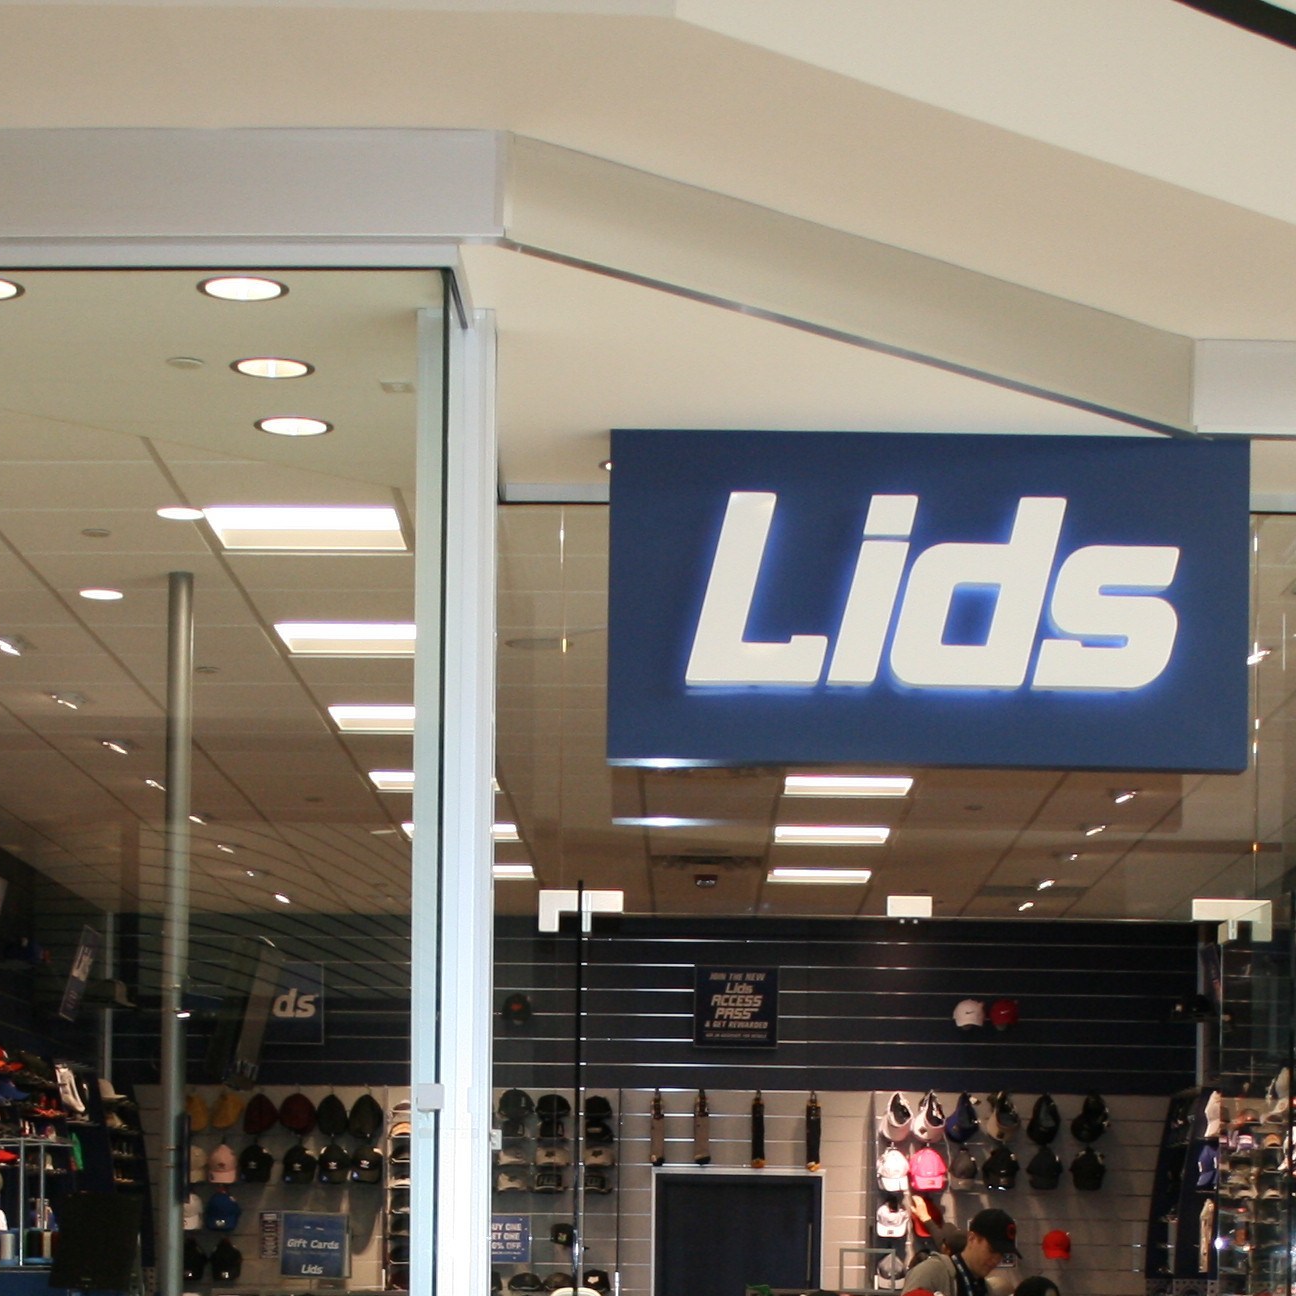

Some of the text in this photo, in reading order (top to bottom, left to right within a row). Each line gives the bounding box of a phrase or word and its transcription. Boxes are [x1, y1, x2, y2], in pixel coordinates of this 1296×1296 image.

[684, 491, 1180, 688] Lids
[729, 973, 743, 981] THE
[745, 973, 766, 981] NEW
[725, 982, 753, 994] Lids
[711, 994, 763, 1007] ACCESS
[715, 1007, 759, 1019] PASS
[492, 1232, 502, 1240] ET
[287, 1239, 339, 1250] Gift Cards
[301, 1264, 323, 1274] Lids
